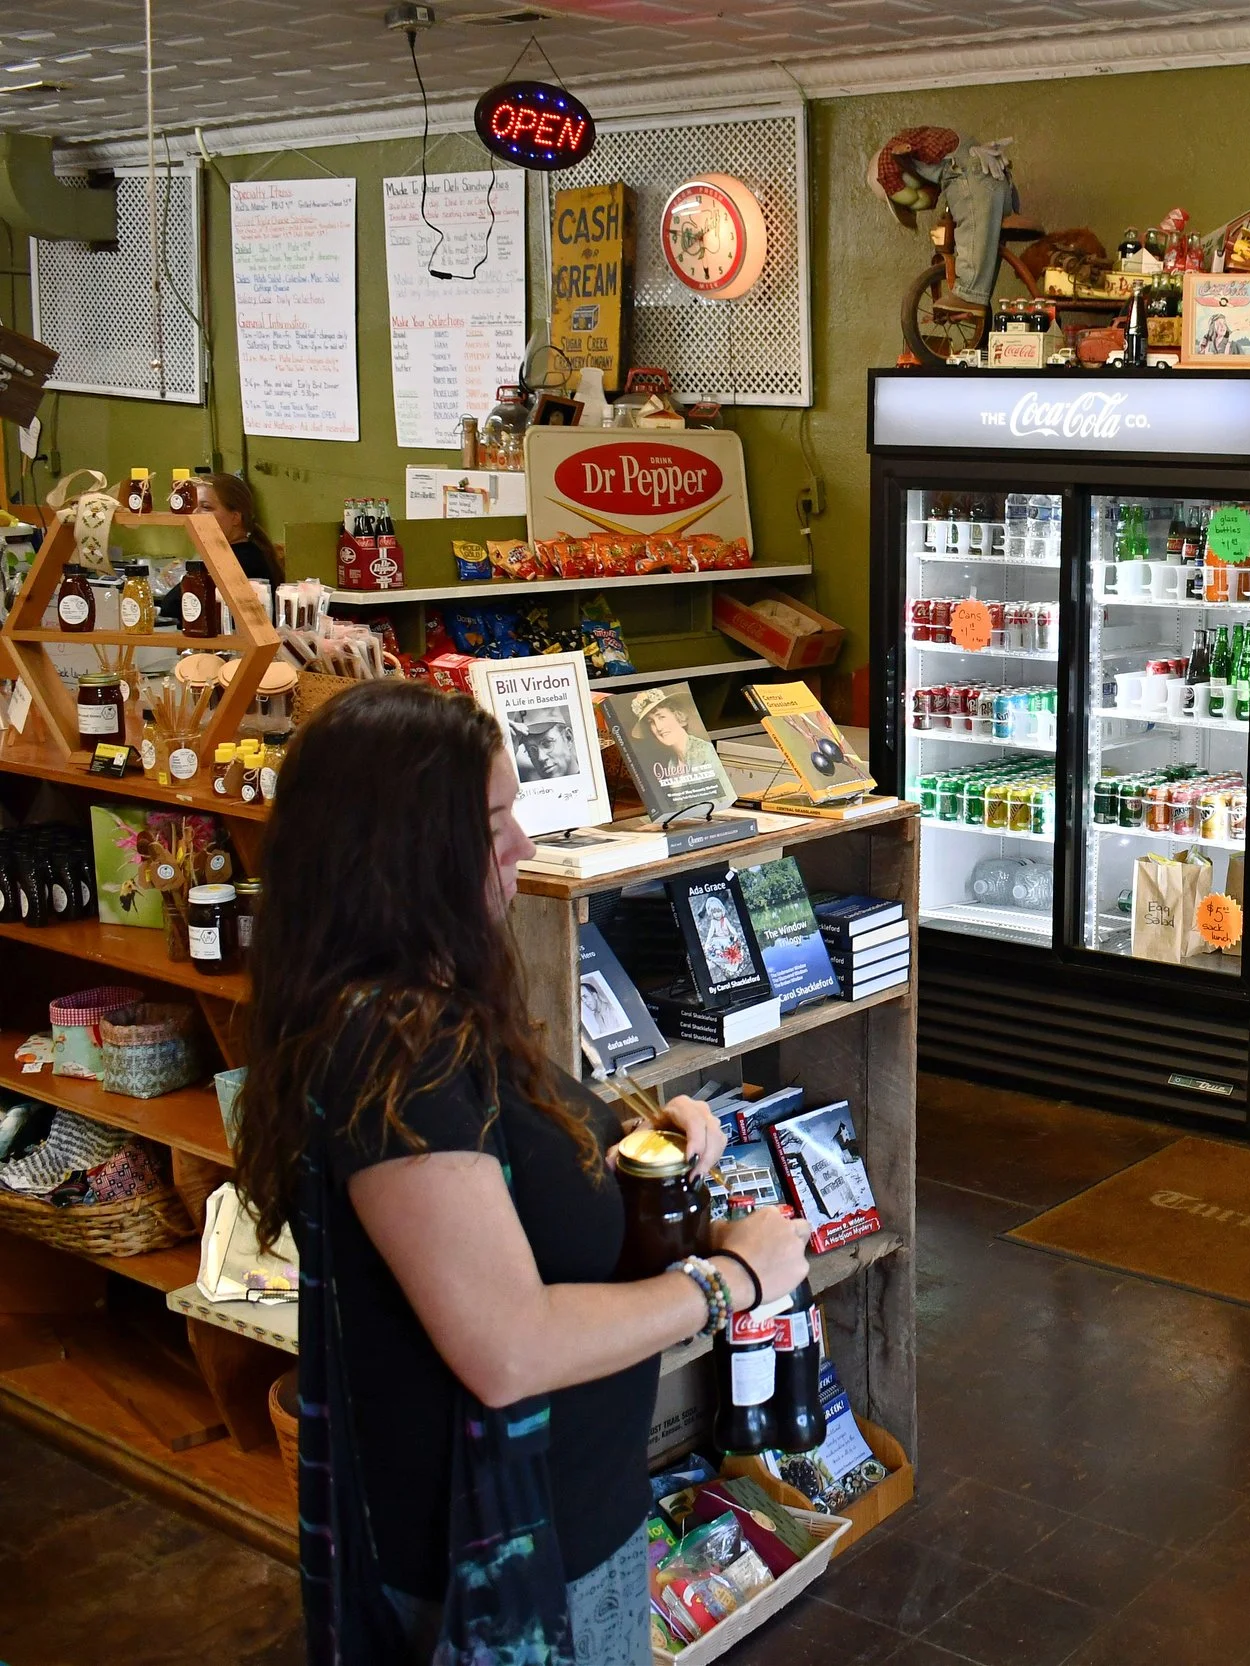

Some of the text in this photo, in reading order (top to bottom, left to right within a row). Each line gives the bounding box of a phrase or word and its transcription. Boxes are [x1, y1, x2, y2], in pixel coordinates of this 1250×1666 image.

[492, 103, 586, 150] OPEN
[385, 179, 460, 196] Made To Deli
[723, 212, 729, 222] 2
[557, 204, 619, 246] CASH
[730, 231, 735, 241] 3
[728, 251, 733, 260] 4
[690, 267, 695, 276] 7
[718, 266, 724, 275] 5
[556, 262, 618, 300] CREAM
[392, 315, 409, 328] Make
[411, 315, 425, 328] Your
[428, 312, 465, 328] Selections
[561, 334, 609, 352] SUGAR CREEK
[1003, 345, 1037, 359] Coca-Cola
[553, 354, 613, 371] CREAMERY COMPANY
[981, 391, 1151, 438] THE Coca-Cola CO.
[650, 456, 673, 465] DRINK
[582, 454, 708, 508] Dr Pepper
[1219, 516, 1239, 528] glass
[1215, 525, 1242, 535] bottles
[462, 544, 481, 552] ROLD
[464, 551, 482, 559] GOLD
[958, 610, 982, 622] Cans
[495, 676, 570, 695] Bill Virdon
[505, 692, 568, 707] A Life in Baseball
[762, 694, 783, 702] Central
[766, 700, 798, 708] Grasslands
[611, 725, 625, 747] Queen
[771, 733, 803, 779] CENTRAL GRASSLANDS
[653, 762, 691, 780] Queen
[519, 787, 554, 800] Bill Virdon
[794, 807, 821, 815] GRASSLANDS
[687, 834, 704, 846] Queen
[688, 881, 727, 897] Ada Grace
[1148, 901, 1171, 917] Egg
[1144, 914, 1175, 929] Salad
[1202, 922, 1225, 933] sack
[764, 920, 808, 941] The Window
[1211, 932, 1232, 943] lunch
[779, 935, 804, 948] Trilogy
[581, 950, 597, 964] Hero
[708, 974, 761, 995] By Carol Shackleford
[777, 976, 834, 1003] Carol Shackleford
[680, 1009, 718, 1023] Carol Shackleford
[679, 1021, 717, 1034] Carol Shackleford
[607, 1034, 640, 1051] darla noble
[680, 1031, 719, 1043] Carol Shackleford
[1196, 1079, 1228, 1094] True
[739, 1118, 747, 1135] DEATH
[824, 1221, 874, 1246] A Mystery
[825, 1215, 866, 1237] James R. Wilder
[663, 1406, 698, 1429] TRAIL SODA
